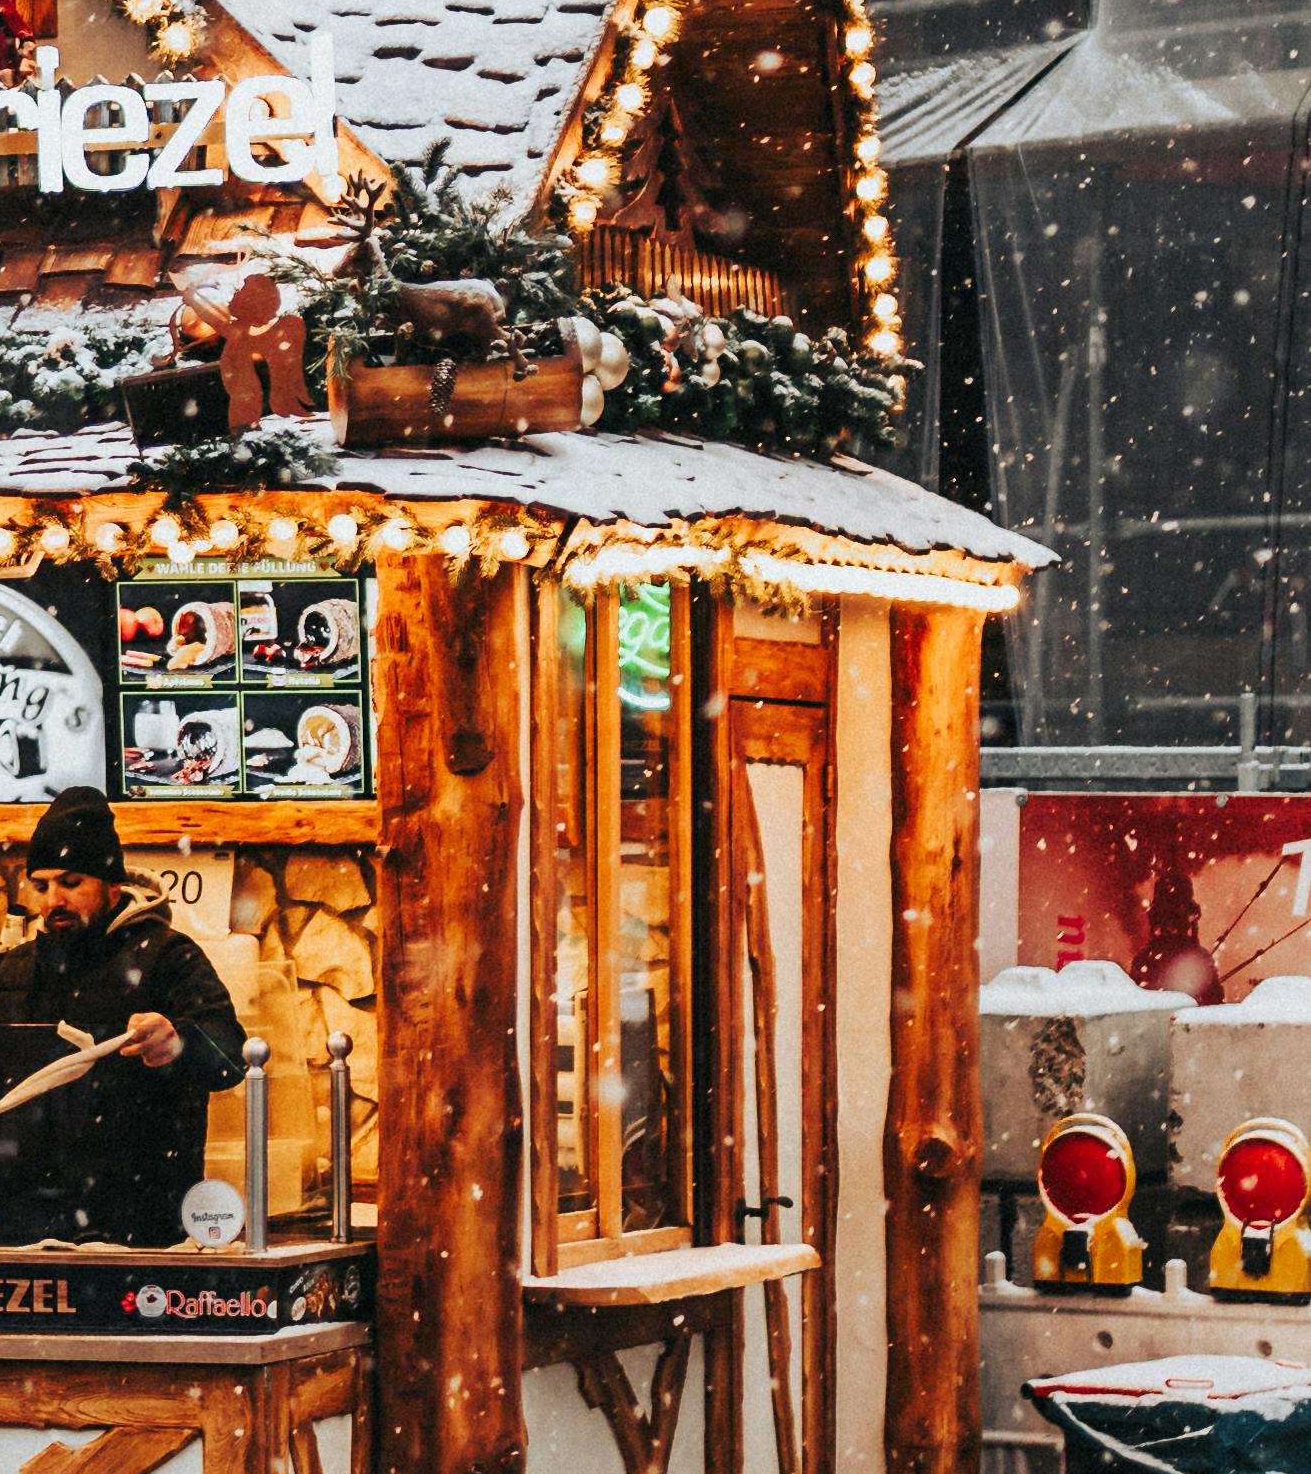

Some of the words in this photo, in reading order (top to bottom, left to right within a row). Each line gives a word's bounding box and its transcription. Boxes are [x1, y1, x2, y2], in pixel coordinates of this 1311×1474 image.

[208, 560, 251, 574] DEE
[190, 1212, 235, 1225] Instagram
[165, 1289, 268, 1319] Raffaello
